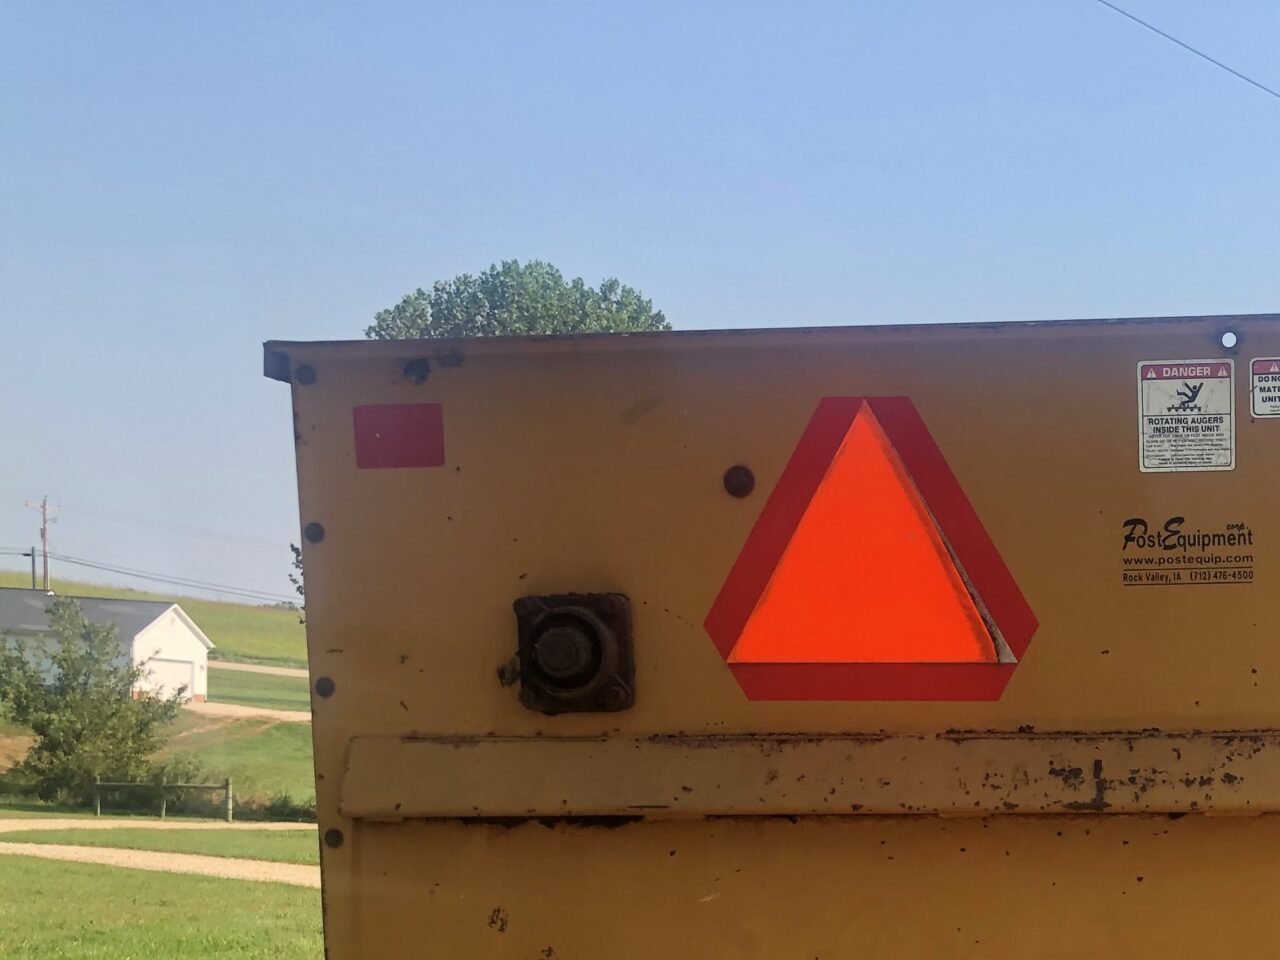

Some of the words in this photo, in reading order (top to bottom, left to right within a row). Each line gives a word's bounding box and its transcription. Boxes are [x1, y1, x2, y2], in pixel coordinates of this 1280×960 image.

[1162, 366, 1211, 377] DANGER
[1257, 375, 1270, 383] DO
[1148, 417, 1189, 425] ROTATING
[1190, 416, 1224, 424] AUGERS
[1153, 426, 1180, 434] INSIDE
[1201, 425, 1220, 433] UNIT
[1122, 553, 1254, 566] www.postequip.com
[1122, 572, 1143, 582] Rock
[1145, 572, 1171, 583] Valley,
[1173, 572, 1182, 581] IA
[1189, 570, 1211, 581] (712)
[1212, 570, 1254, 580] 476-4500
